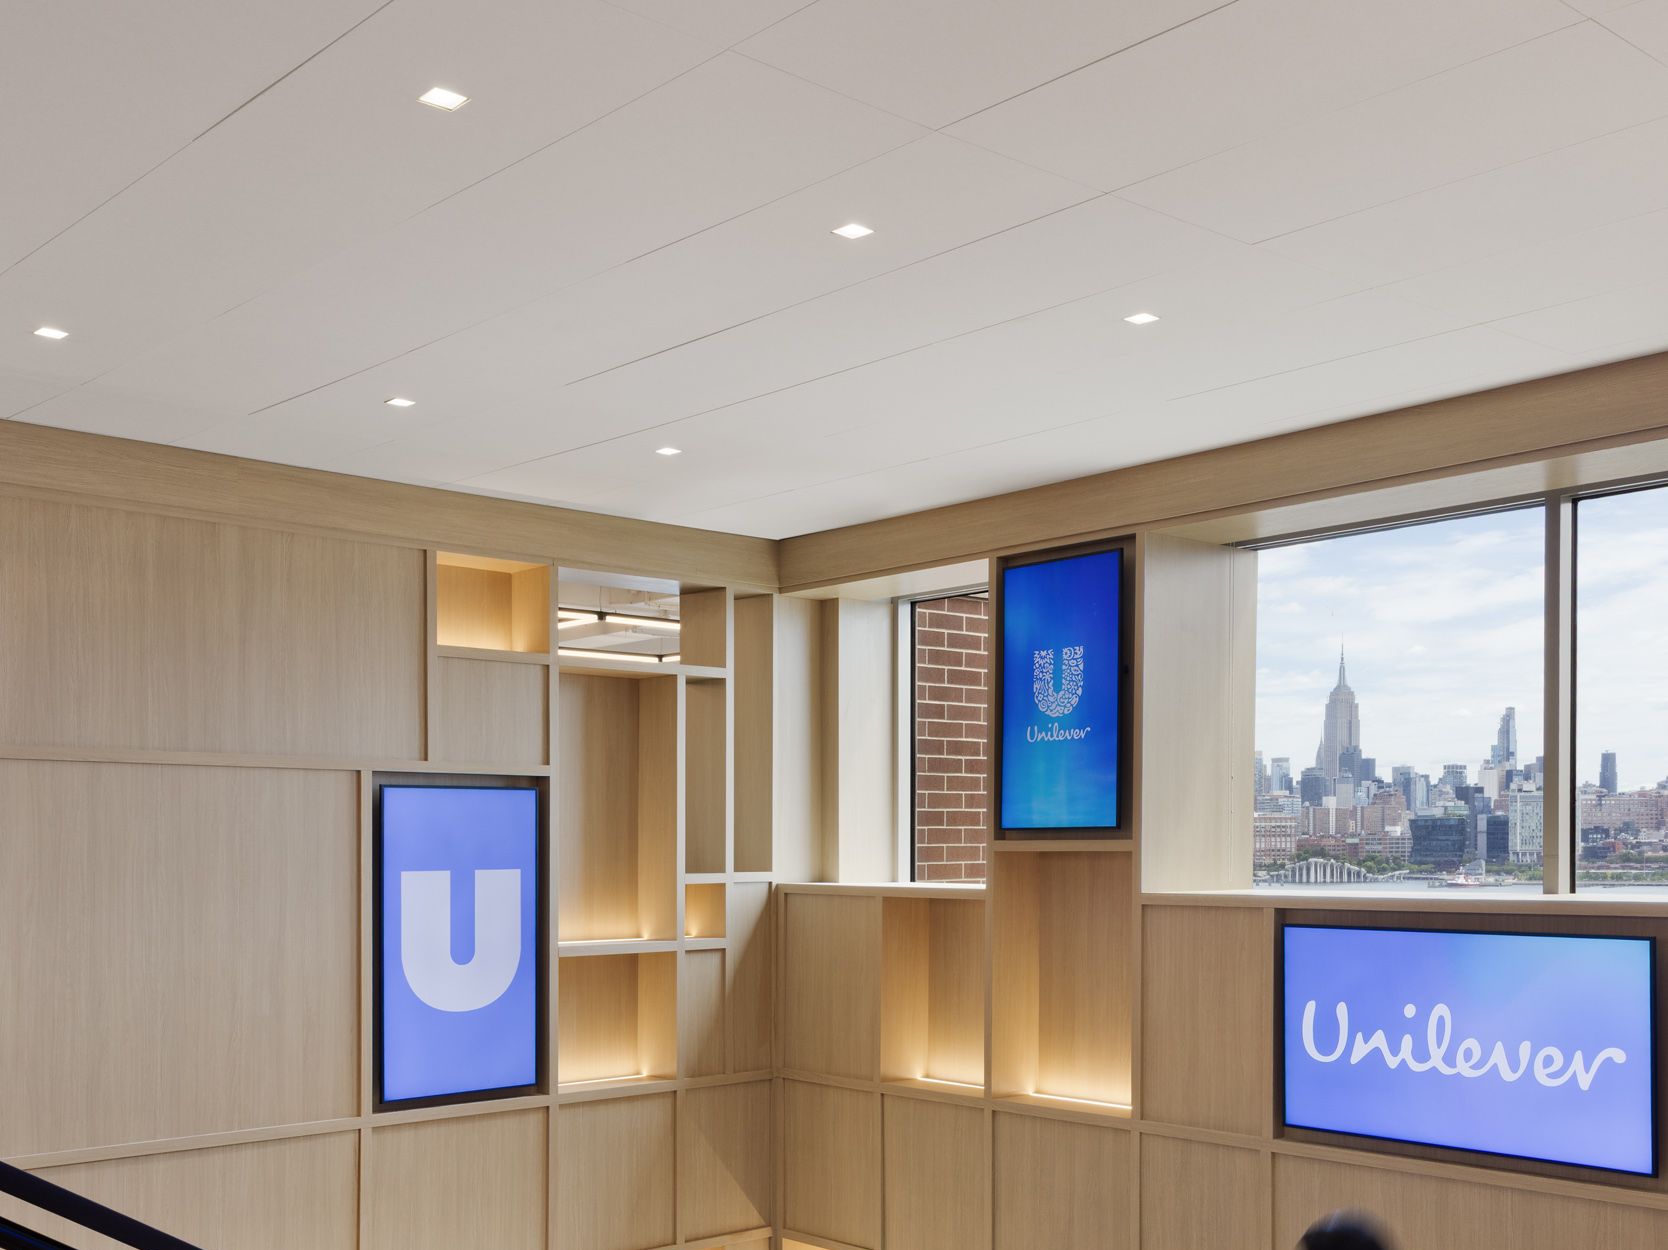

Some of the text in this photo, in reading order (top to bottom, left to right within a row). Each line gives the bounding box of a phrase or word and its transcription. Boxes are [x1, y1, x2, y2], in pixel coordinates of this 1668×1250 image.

[1033, 645, 1085, 717] U
[1027, 722, 1091, 743] Unilever
[401, 868, 521, 1012] U
[1302, 1000, 1627, 1091] Unilever
